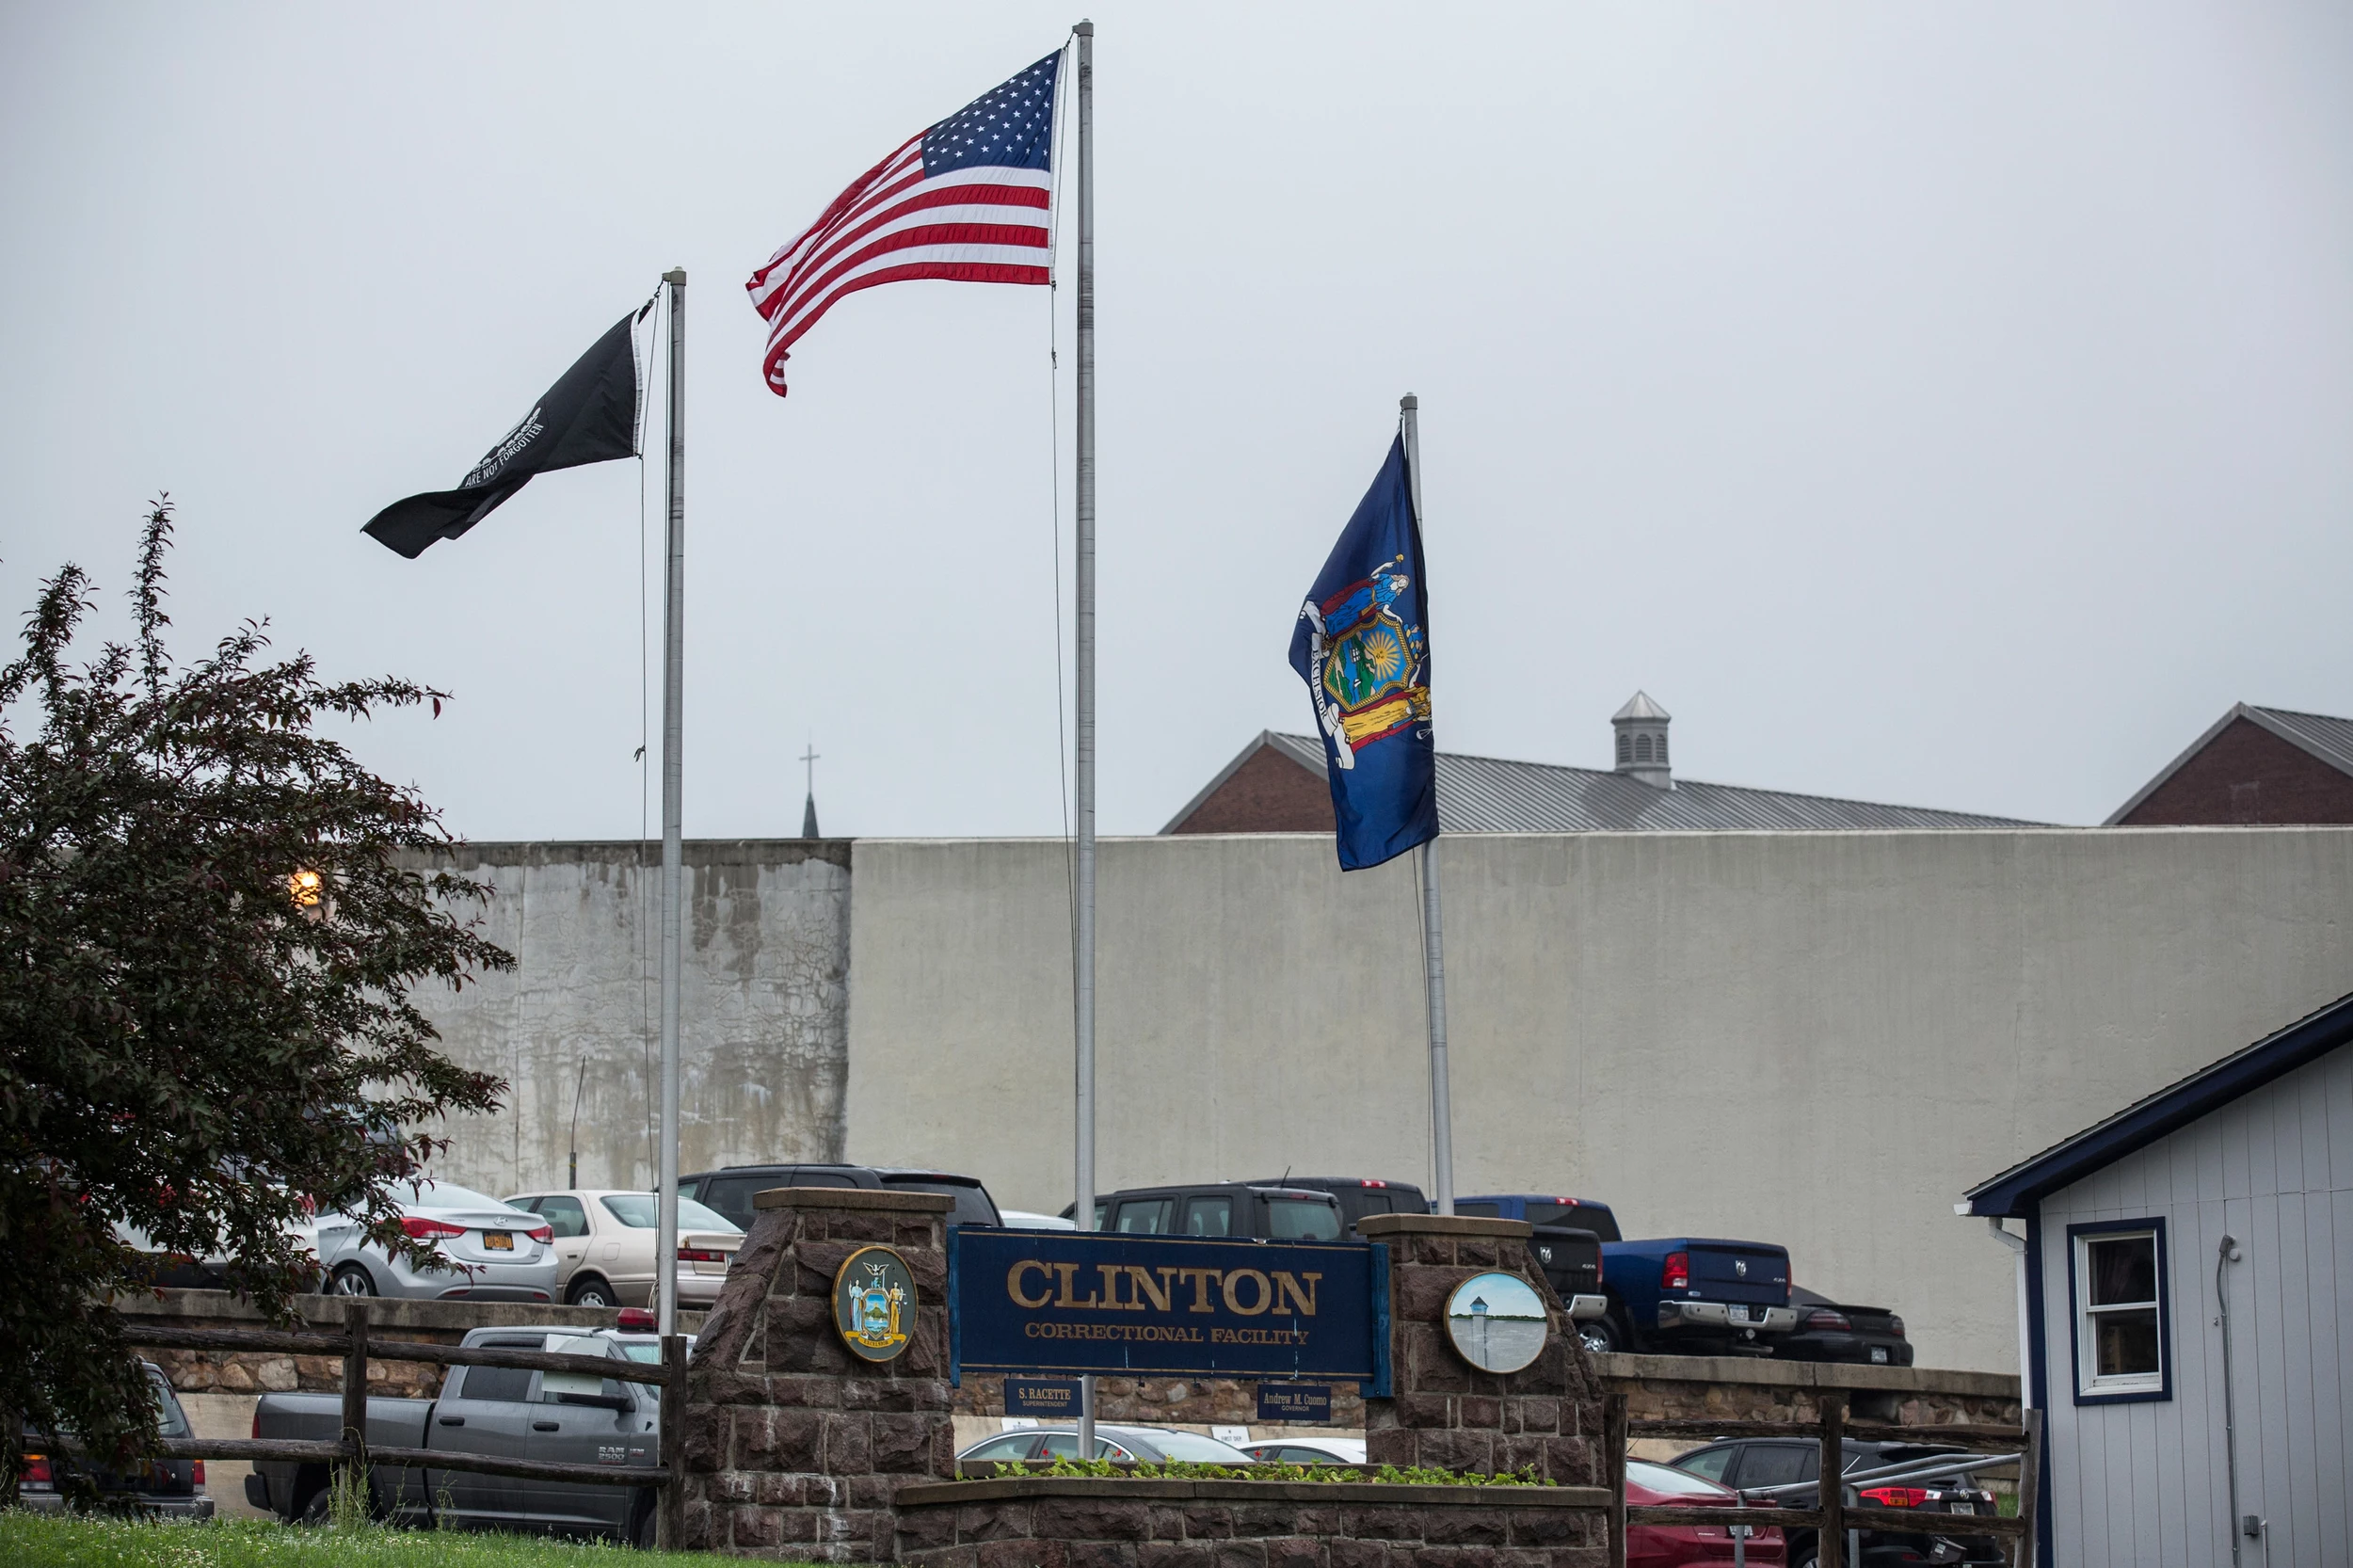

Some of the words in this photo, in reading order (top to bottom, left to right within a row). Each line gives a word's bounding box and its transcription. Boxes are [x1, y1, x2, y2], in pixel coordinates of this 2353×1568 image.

[465, 472, 481, 488] ARE
[483, 461, 498, 479] NOT
[499, 423, 544, 466] FORGOTTEN
[1312, 649, 1328, 720] EXCELSIOR
[1007, 1259, 1322, 1316] CLINTON
[1025, 1322, 1204, 1343] CORRECTIONAL
[1211, 1328, 1309, 1345] FACILITY
[1018, 1387, 1028, 1400] S.
[1029, 1388, 1071, 1400] RACETTE
[1264, 1393, 1291, 1404] Andrew
[1294, 1393, 1303, 1405] M.
[1305, 1394, 1327, 1406] Cuomo
